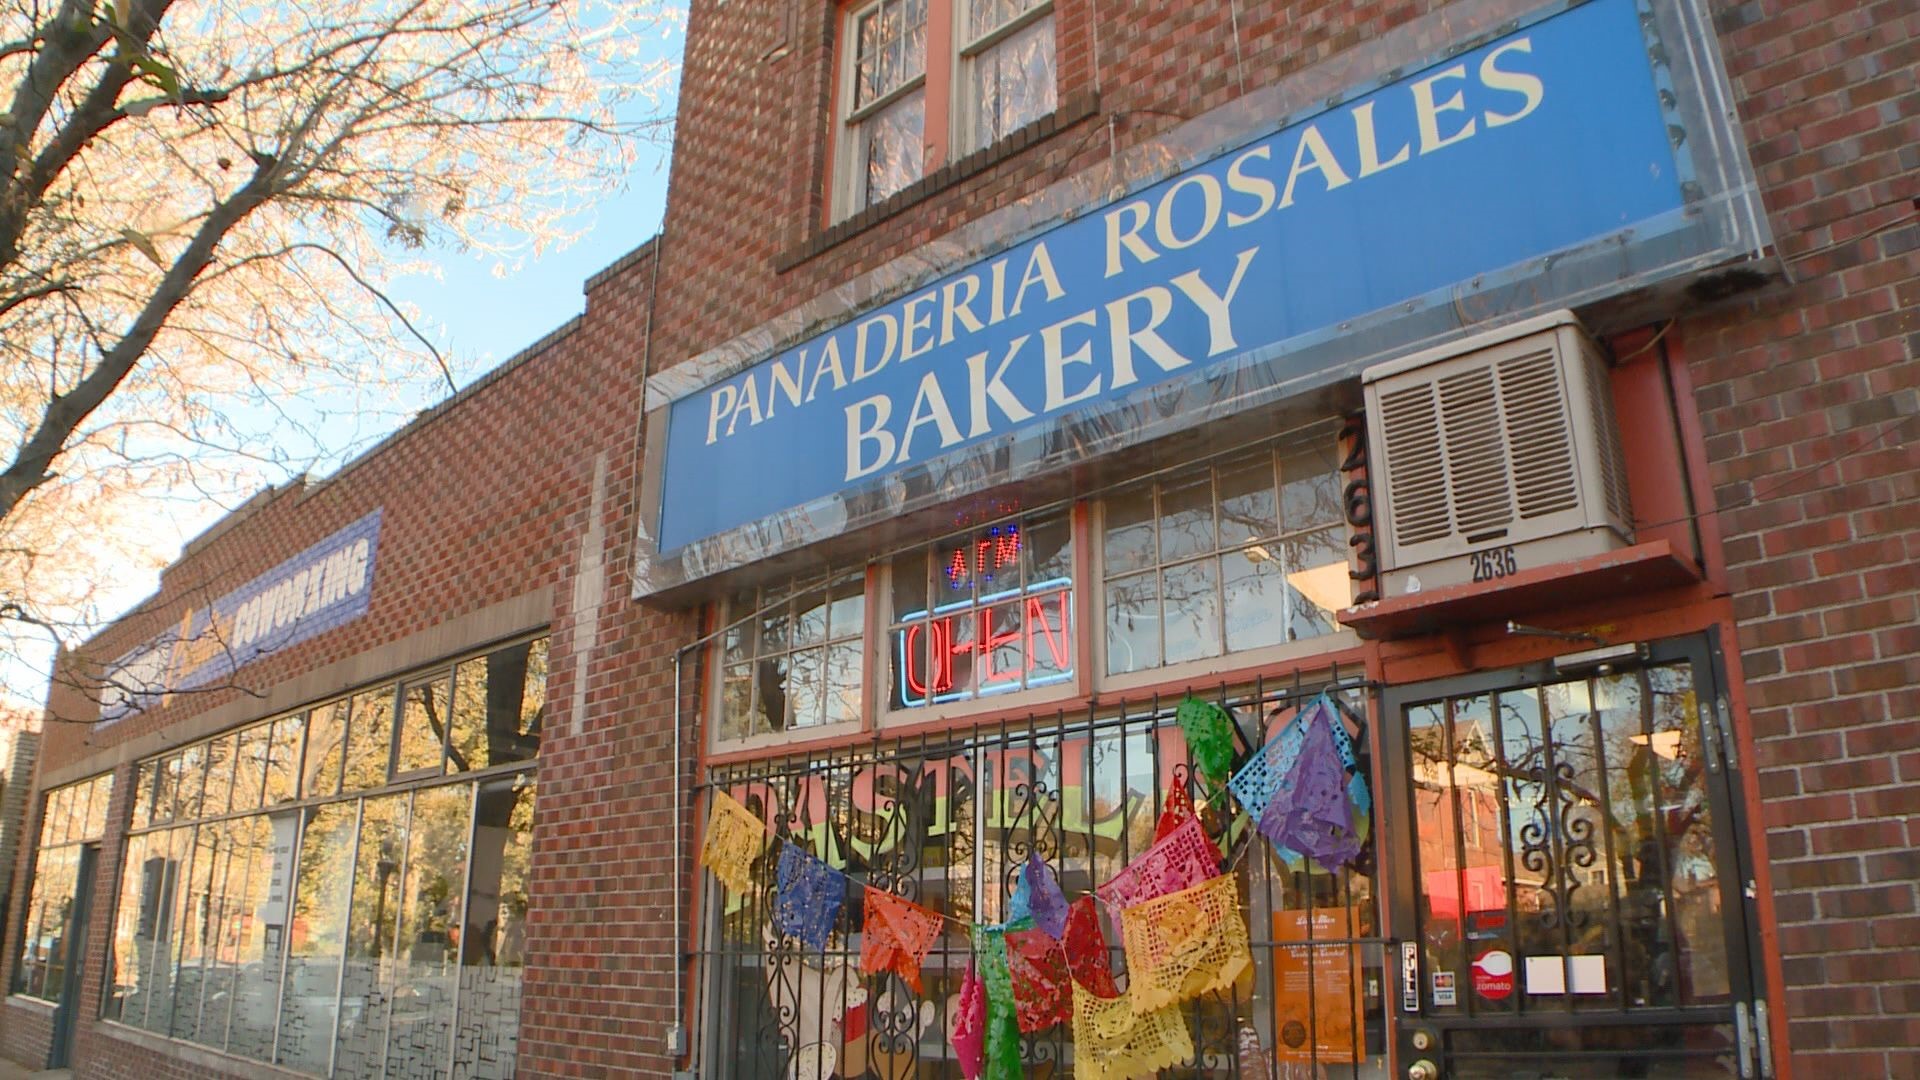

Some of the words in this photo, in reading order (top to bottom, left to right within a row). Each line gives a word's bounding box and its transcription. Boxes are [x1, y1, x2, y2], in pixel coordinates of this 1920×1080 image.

[704, 241, 1066, 445] PANADERIA
[1103, 36, 1545, 279] ROSALES
[843, 246, 1260, 482] BAKERY
[950, 533, 1018, 581] ATM
[1469, 547, 1517, 583] 2636
[232, 538, 370, 649] COWORKING
[1404, 946, 1416, 994] PULL
[1476, 982, 1512, 991] zomato
